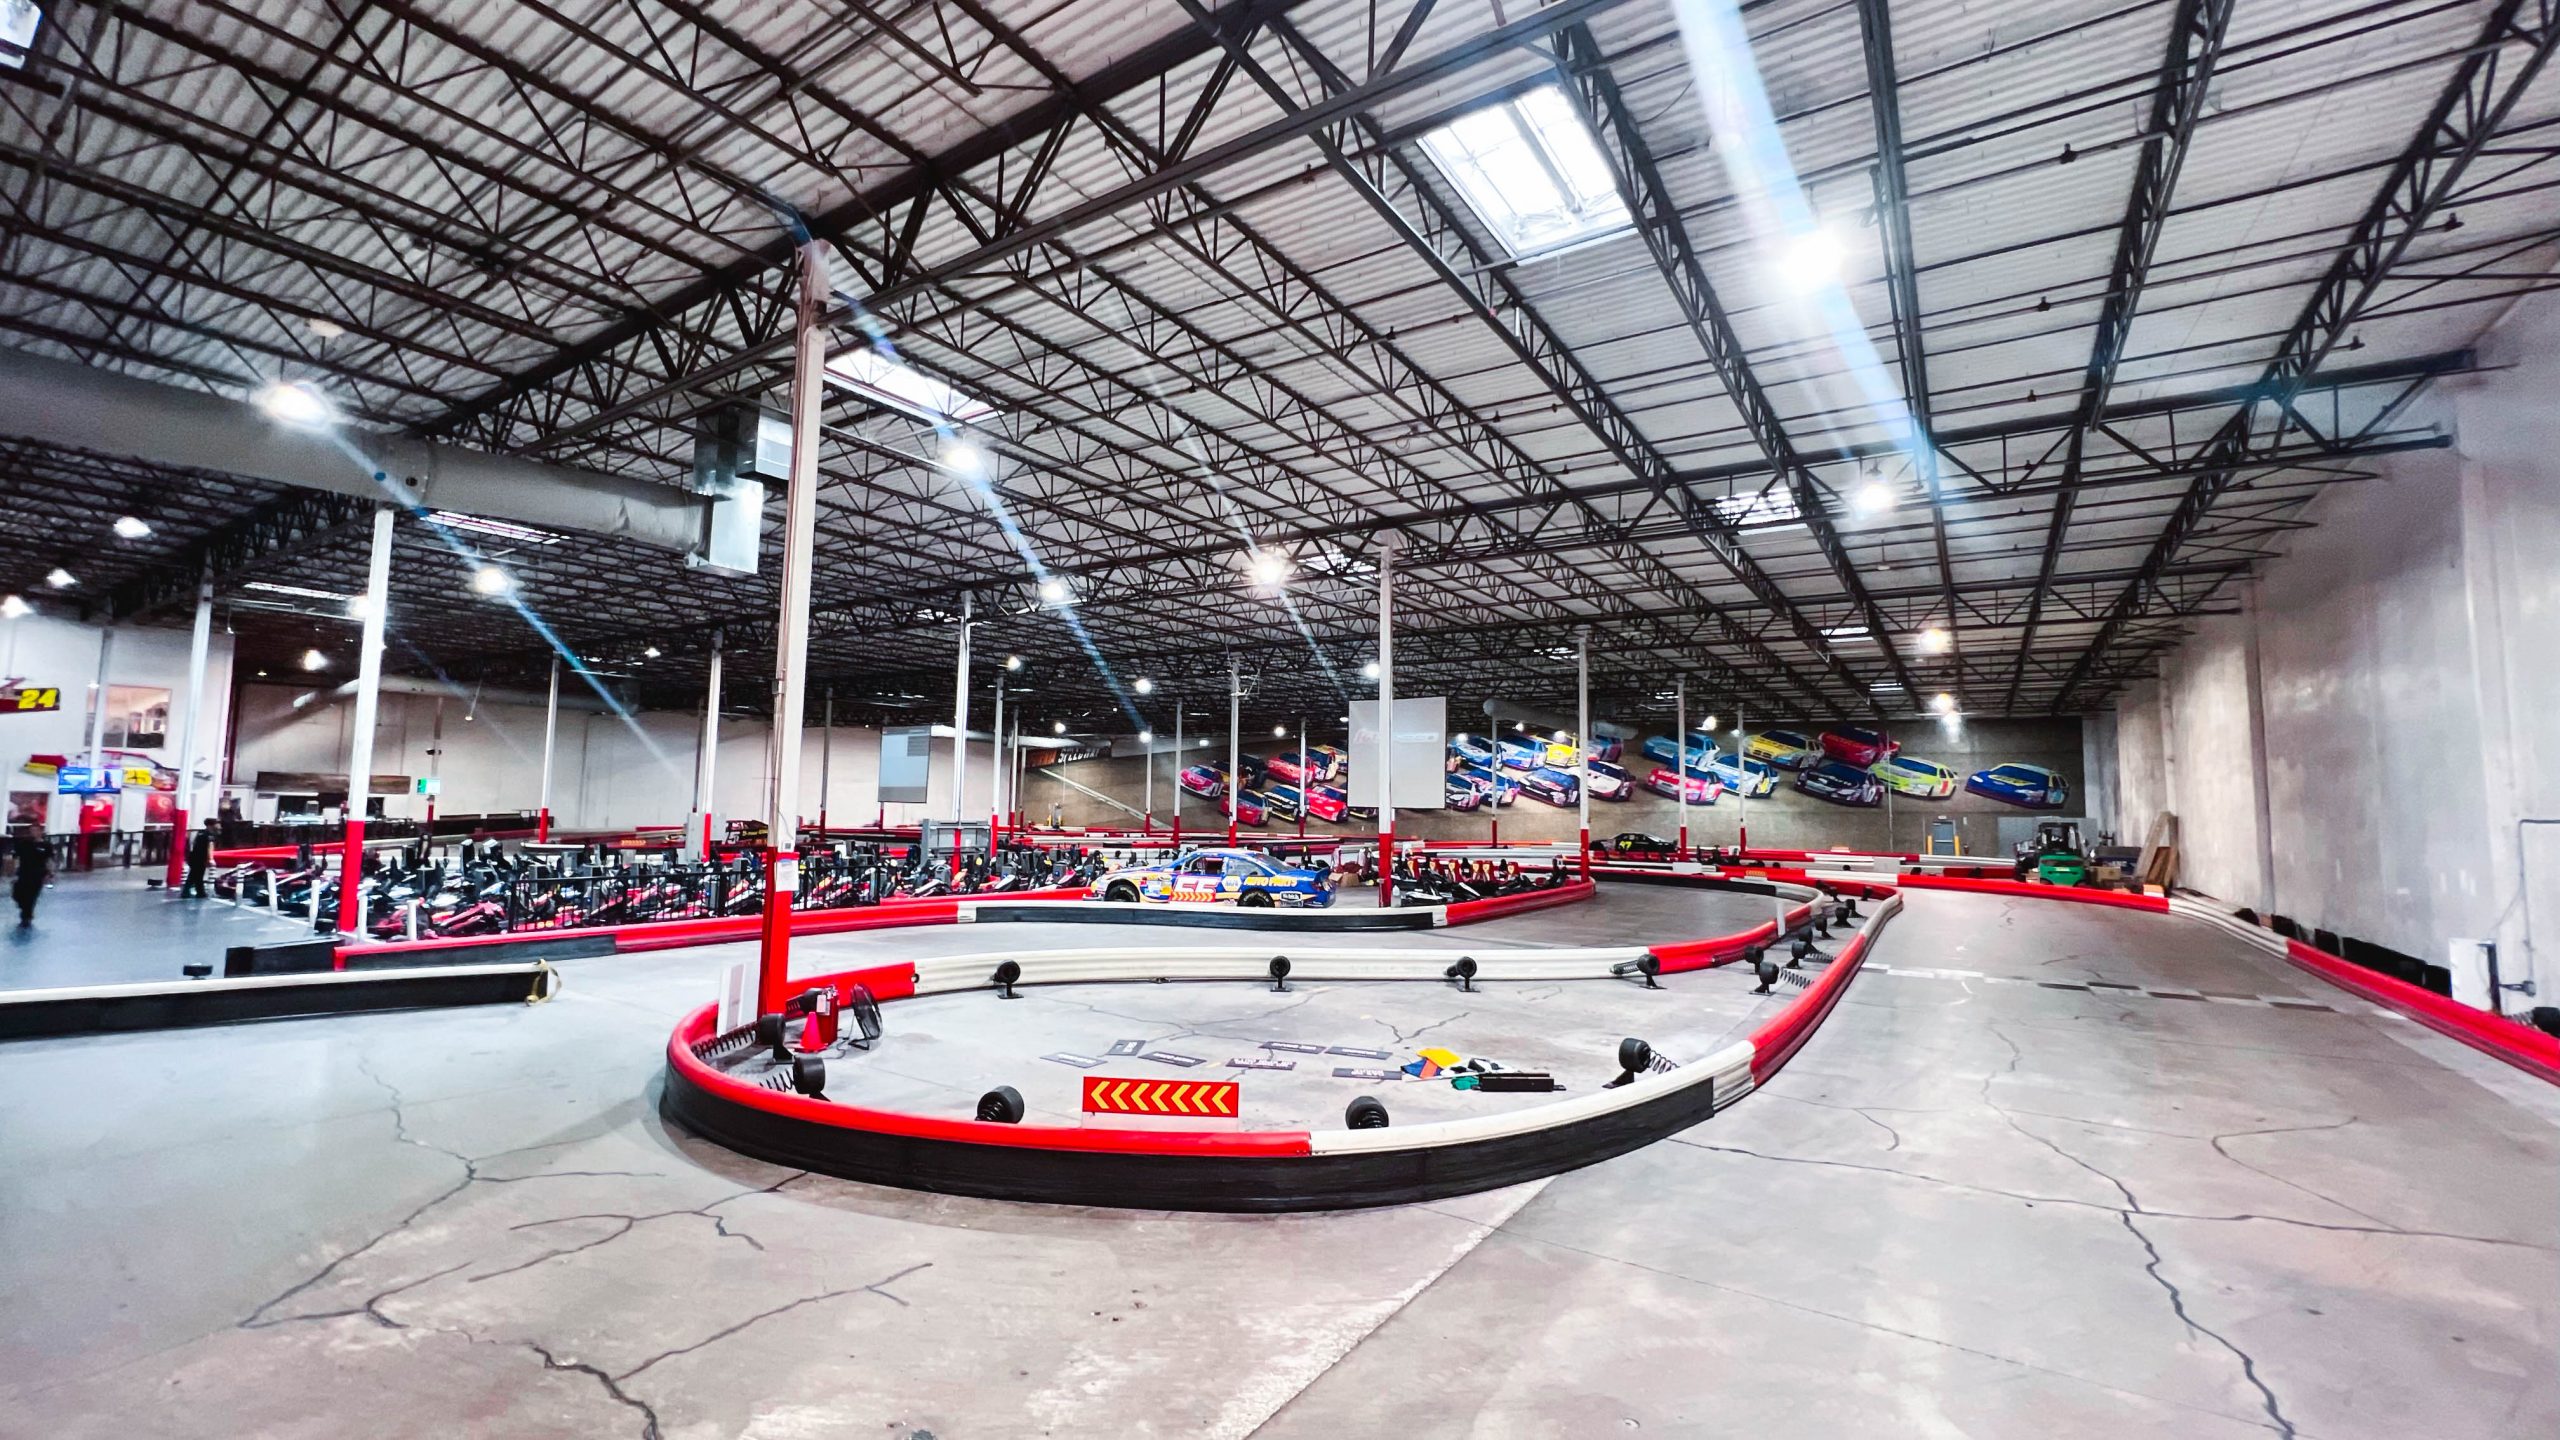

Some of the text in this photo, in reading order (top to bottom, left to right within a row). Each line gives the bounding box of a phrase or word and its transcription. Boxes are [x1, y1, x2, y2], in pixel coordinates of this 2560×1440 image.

[18, 689, 58, 709] 24
[1243, 876, 1268, 887] AUTO
[1268, 876, 1298, 888] PARTS
